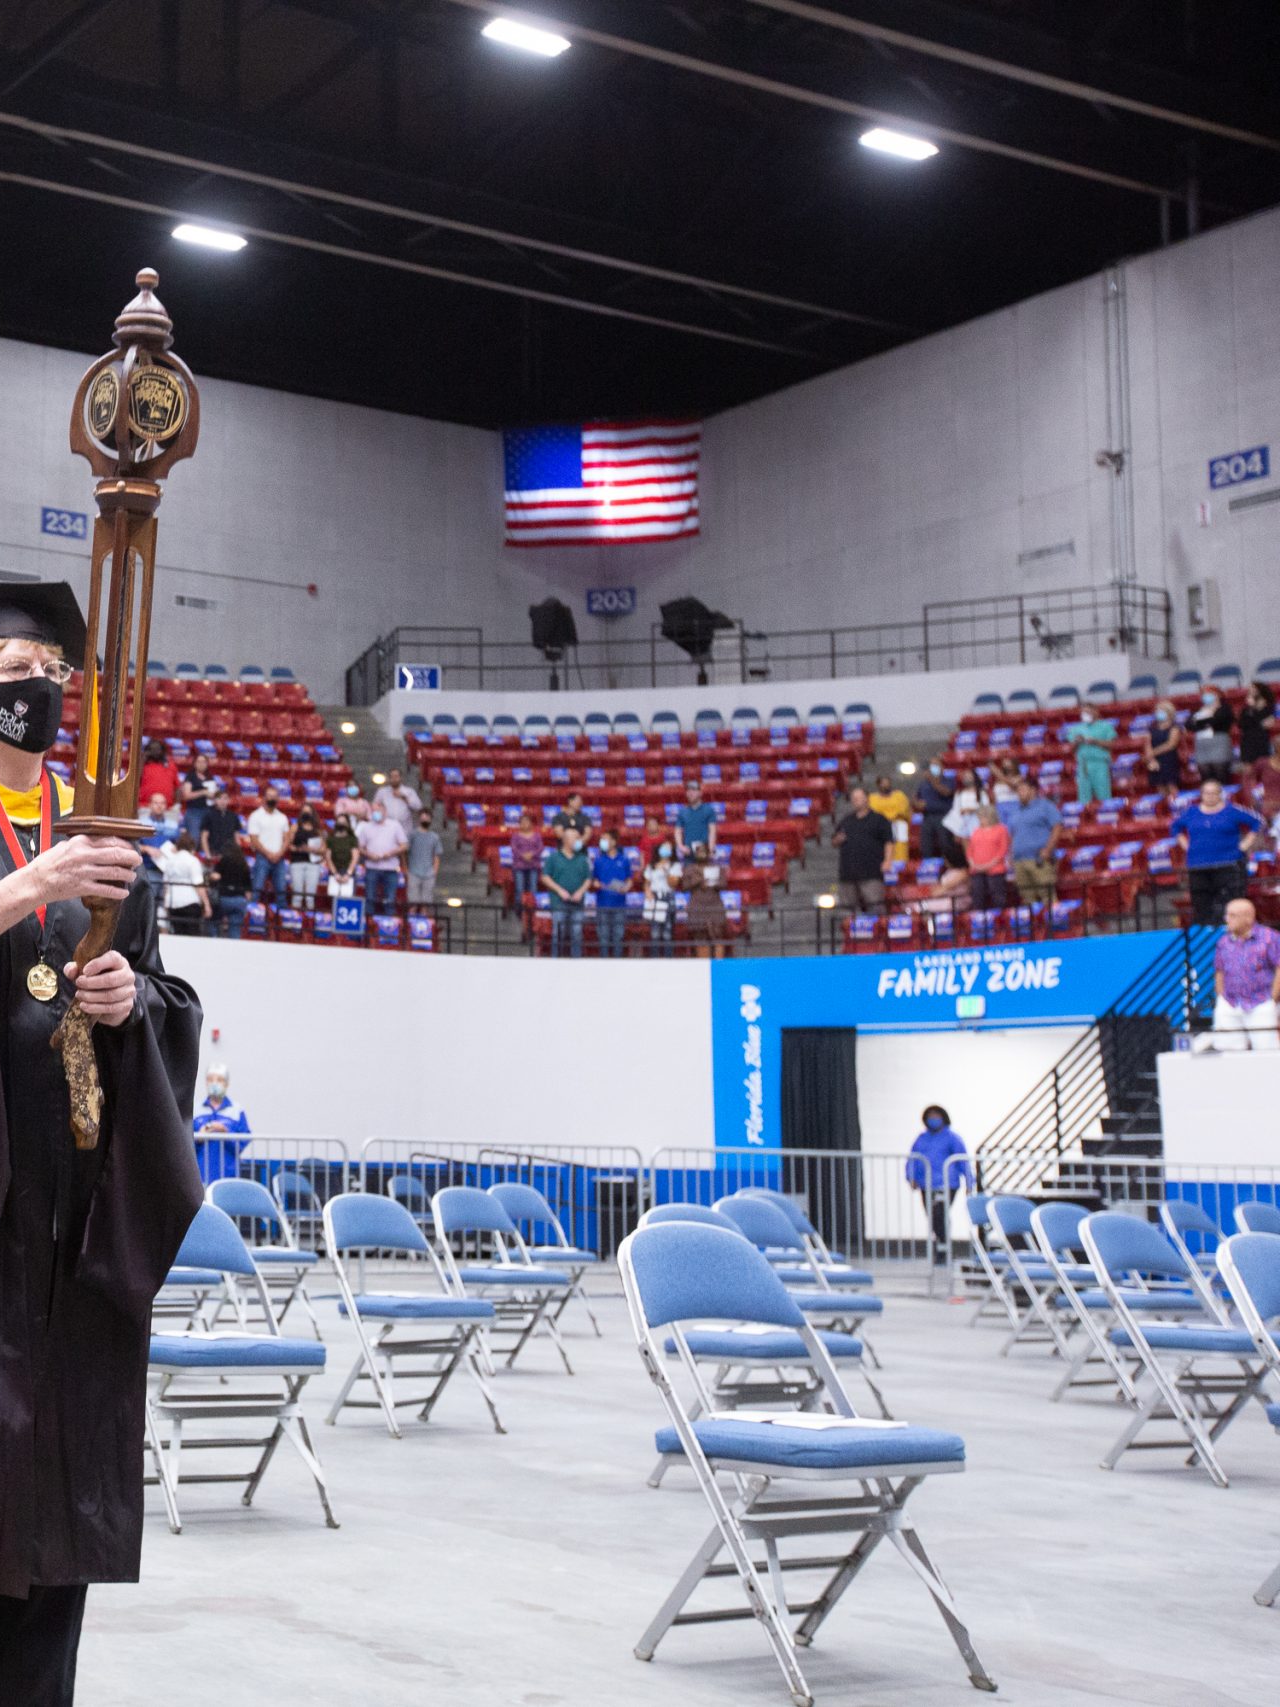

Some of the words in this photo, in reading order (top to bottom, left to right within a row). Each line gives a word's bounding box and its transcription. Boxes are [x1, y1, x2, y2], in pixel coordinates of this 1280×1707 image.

[1213, 450, 1262, 486] 204
[45, 511, 84, 537] 234
[591, 590, 632, 611] 203
[0, 706, 26, 734] POLK
[337, 906, 359, 926] 34
[913, 950, 982, 969] LAKELAND
[877, 963, 980, 999] FAMILY
[986, 956, 1062, 993] ZONE
[742, 1023, 763, 1069] Blue
[743, 1069, 764, 1146] Florida
